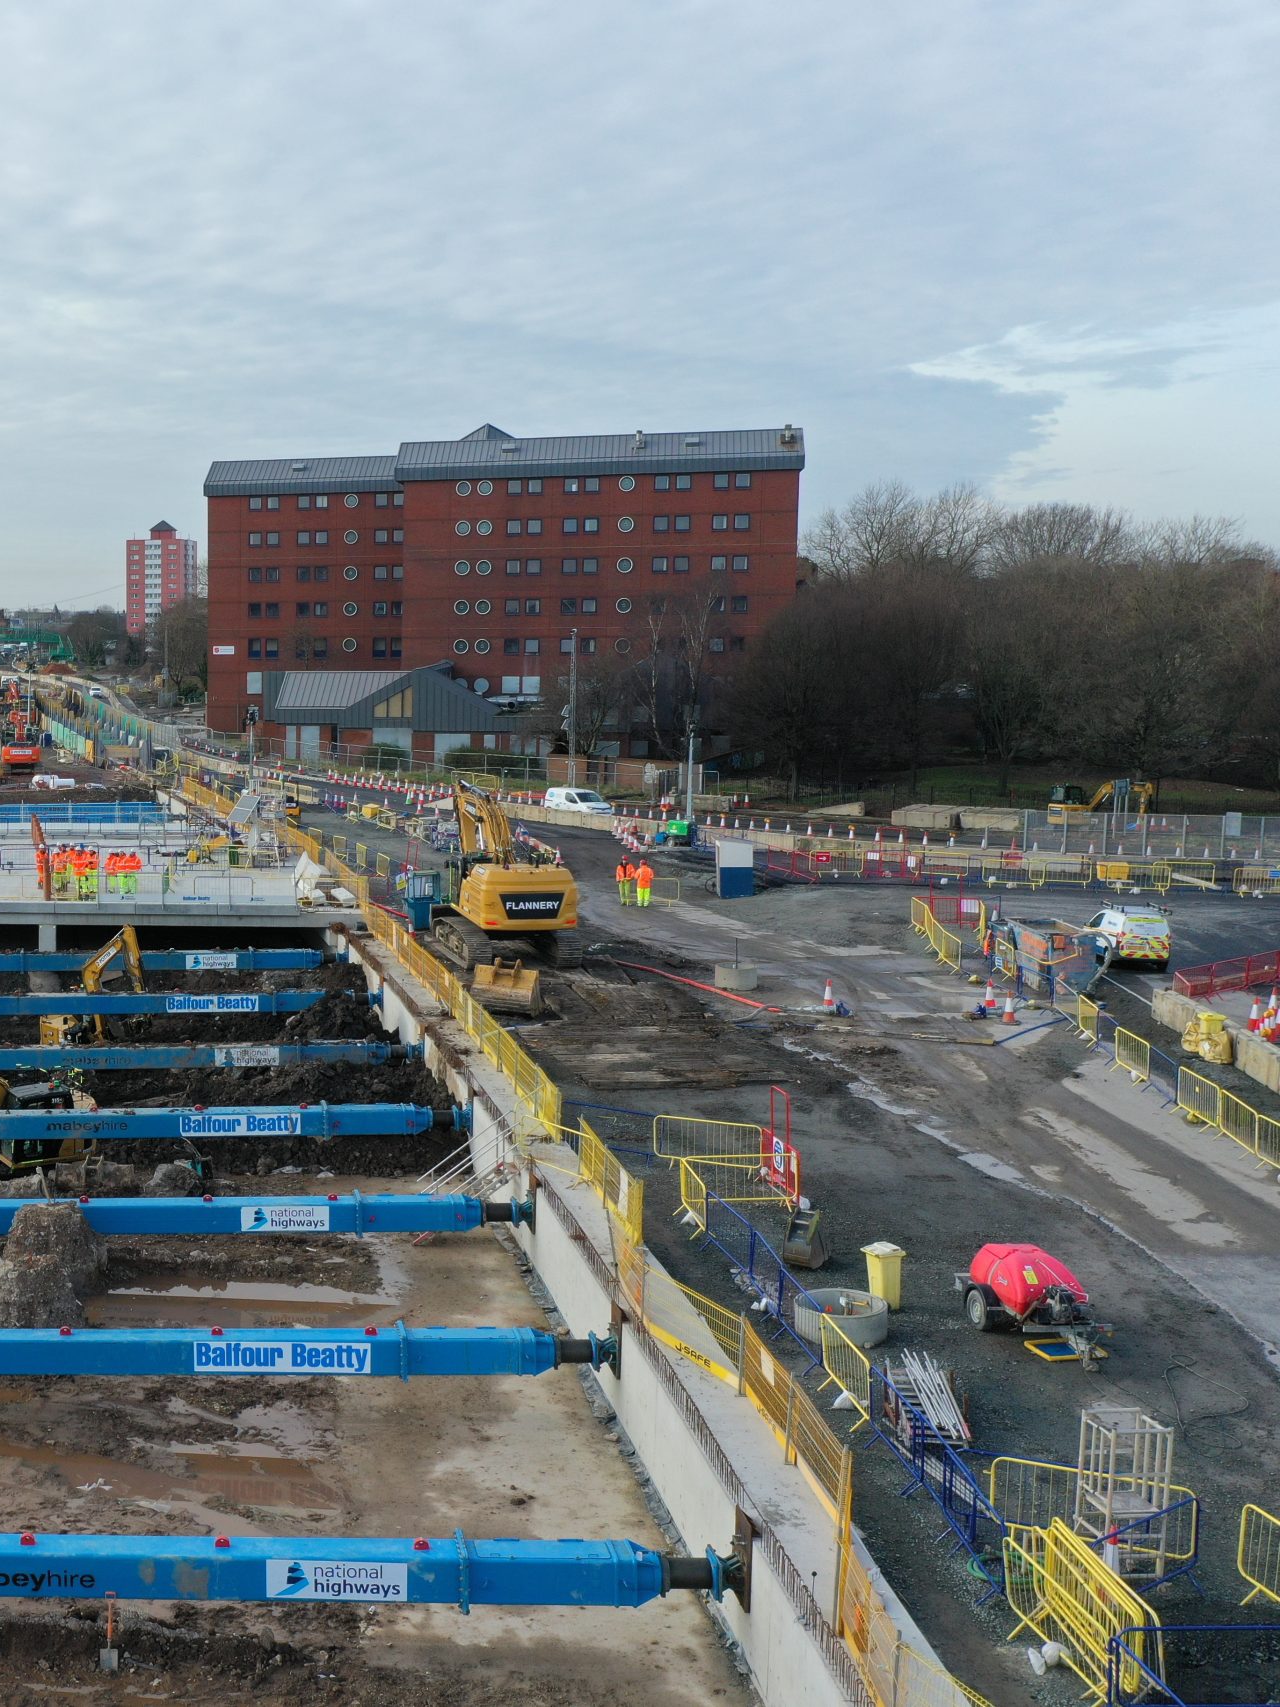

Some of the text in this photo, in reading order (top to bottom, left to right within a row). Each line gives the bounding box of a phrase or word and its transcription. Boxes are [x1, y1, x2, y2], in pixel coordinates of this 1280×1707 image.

[505, 901, 560, 910] FLANNERY
[167, 997, 257, 1010] Balfour Beatty
[236, 1056, 277, 1065] highways
[181, 1115, 299, 1134] Balfour Beatty
[270, 1208, 314, 1217] national
[270, 1218, 325, 1229] highways
[196, 1343, 368, 1373] Balfour Beatty
[313, 1563, 383, 1579] national
[313, 1579, 401, 1598] highways
